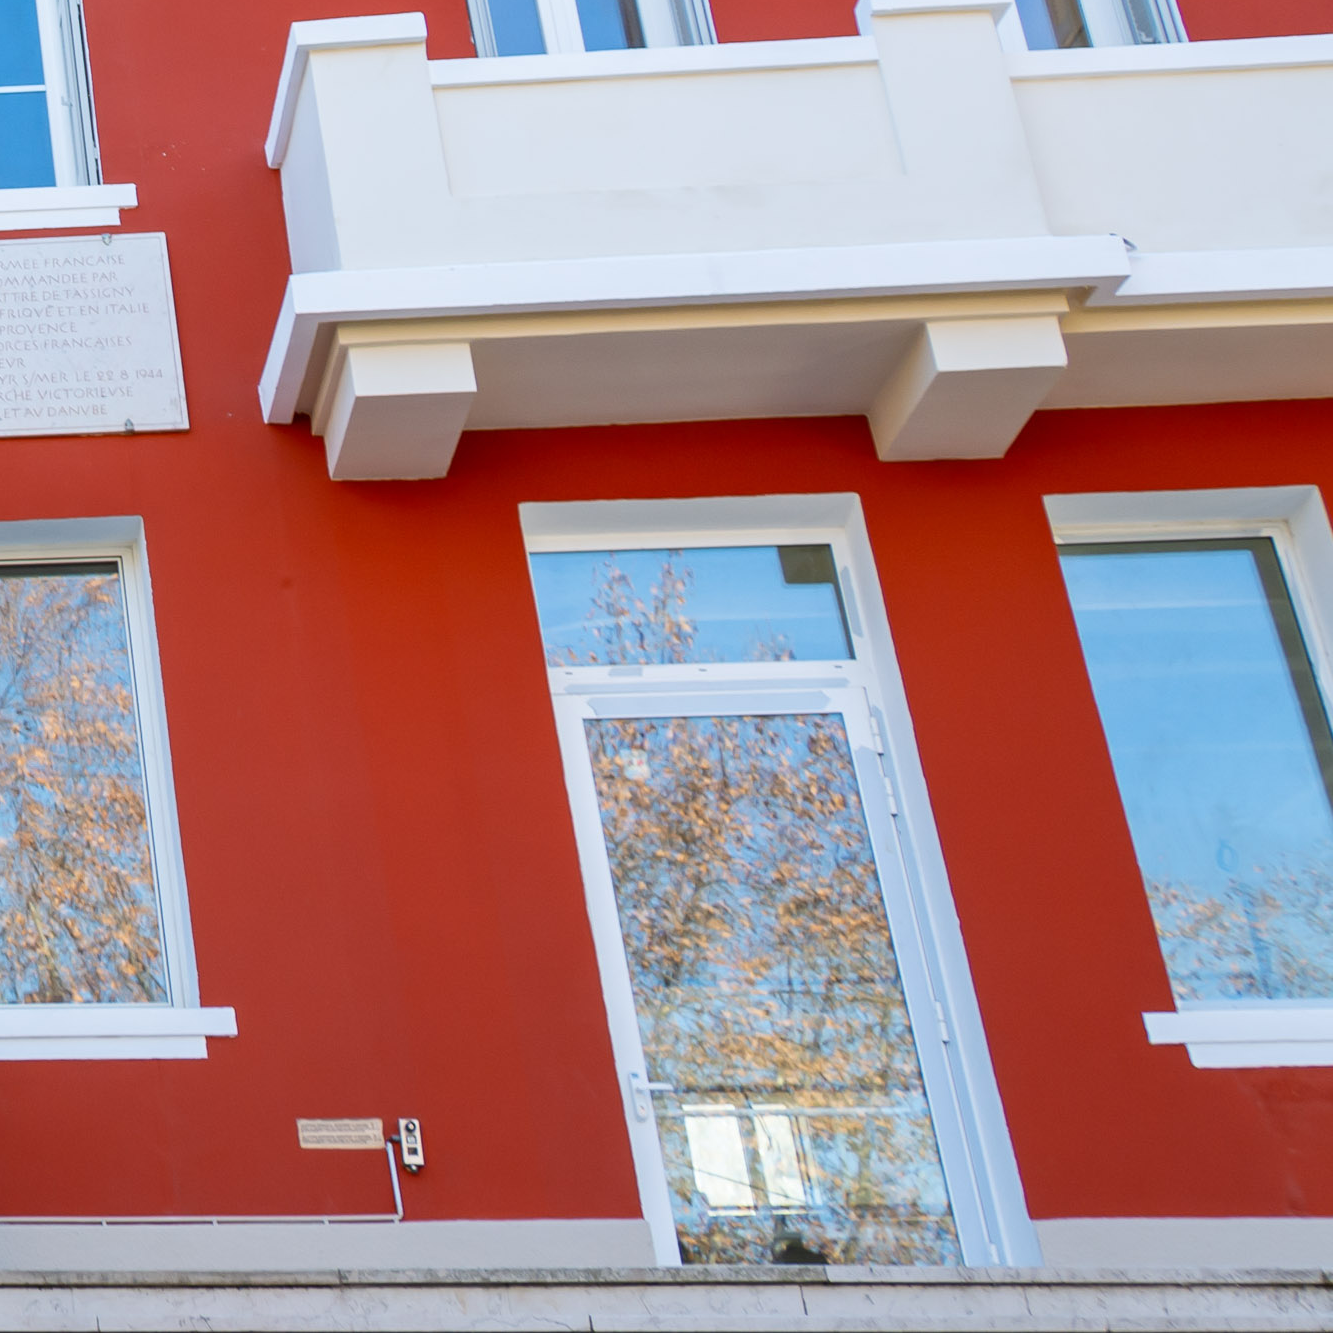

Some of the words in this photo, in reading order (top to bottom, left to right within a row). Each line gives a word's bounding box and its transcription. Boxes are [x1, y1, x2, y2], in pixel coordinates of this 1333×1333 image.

[92, 272, 118, 283] PAR
[42, 290, 62, 302] DE
[65, 286, 135, 301] TASSIGNY
[57, 306, 76, 317] ET
[79, 305, 100, 316] EN
[105, 302, 150, 315] ITALIE
[0, 321, 78, 336] PROVENCE
[76, 370, 92, 382] LE
[135, 368, 163, 380] 1944
[4, 408, 22, 419] ET
